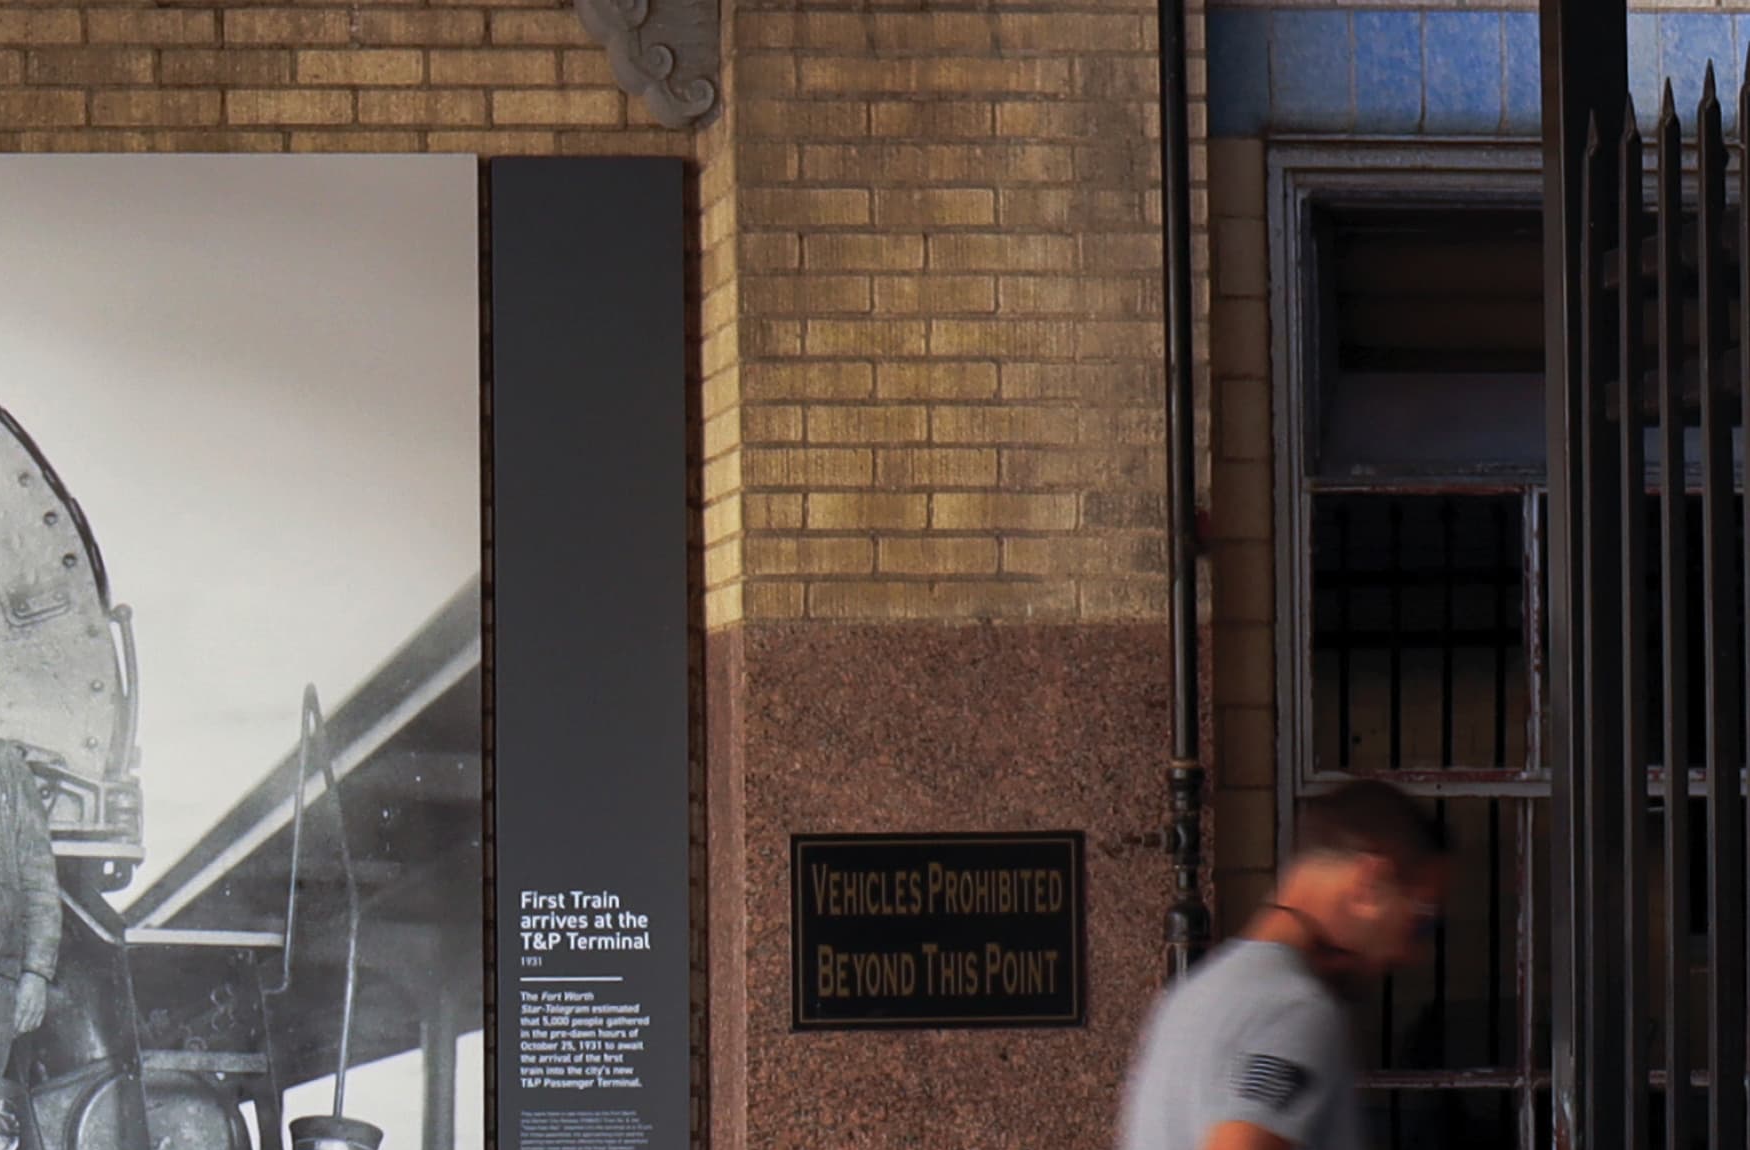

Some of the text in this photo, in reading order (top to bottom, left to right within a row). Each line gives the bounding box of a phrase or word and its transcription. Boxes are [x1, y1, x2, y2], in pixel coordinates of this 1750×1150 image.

[811, 861, 1063, 916] VEHICLES PROHIBITED
[520, 891, 620, 910] First Train
[520, 911, 648, 929] arrives at the
[520, 931, 651, 951] T&P Terminal
[521, 955, 543, 967] 1931
[817, 942, 1058, 998] BEYOND THIS POINT
[520, 991, 595, 1001] The Fort Worth
[521, 1003, 640, 1015] Star-Telegram estimated
[520, 1016, 540, 1026] that
[571, 1016, 604, 1028] people
[605, 1015, 650, 1028] gathered
[521, 1028, 639, 1040] in the pre-dawn hours of
[520, 1041, 558, 1051] October
[579, 1040, 602, 1050] 1931
[604, 1041, 615, 1050] to
[617, 1041, 644, 1051] await
[520, 1053, 623, 1063] the arrival of the first
[520, 1066, 544, 1075] train
[545, 1066, 565, 1075] into
[567, 1066, 583, 1075] the
[612, 1066, 635, 1075] new
[520, 1078, 542, 1088] T&P
[543, 1078, 595, 1090] Passenger
